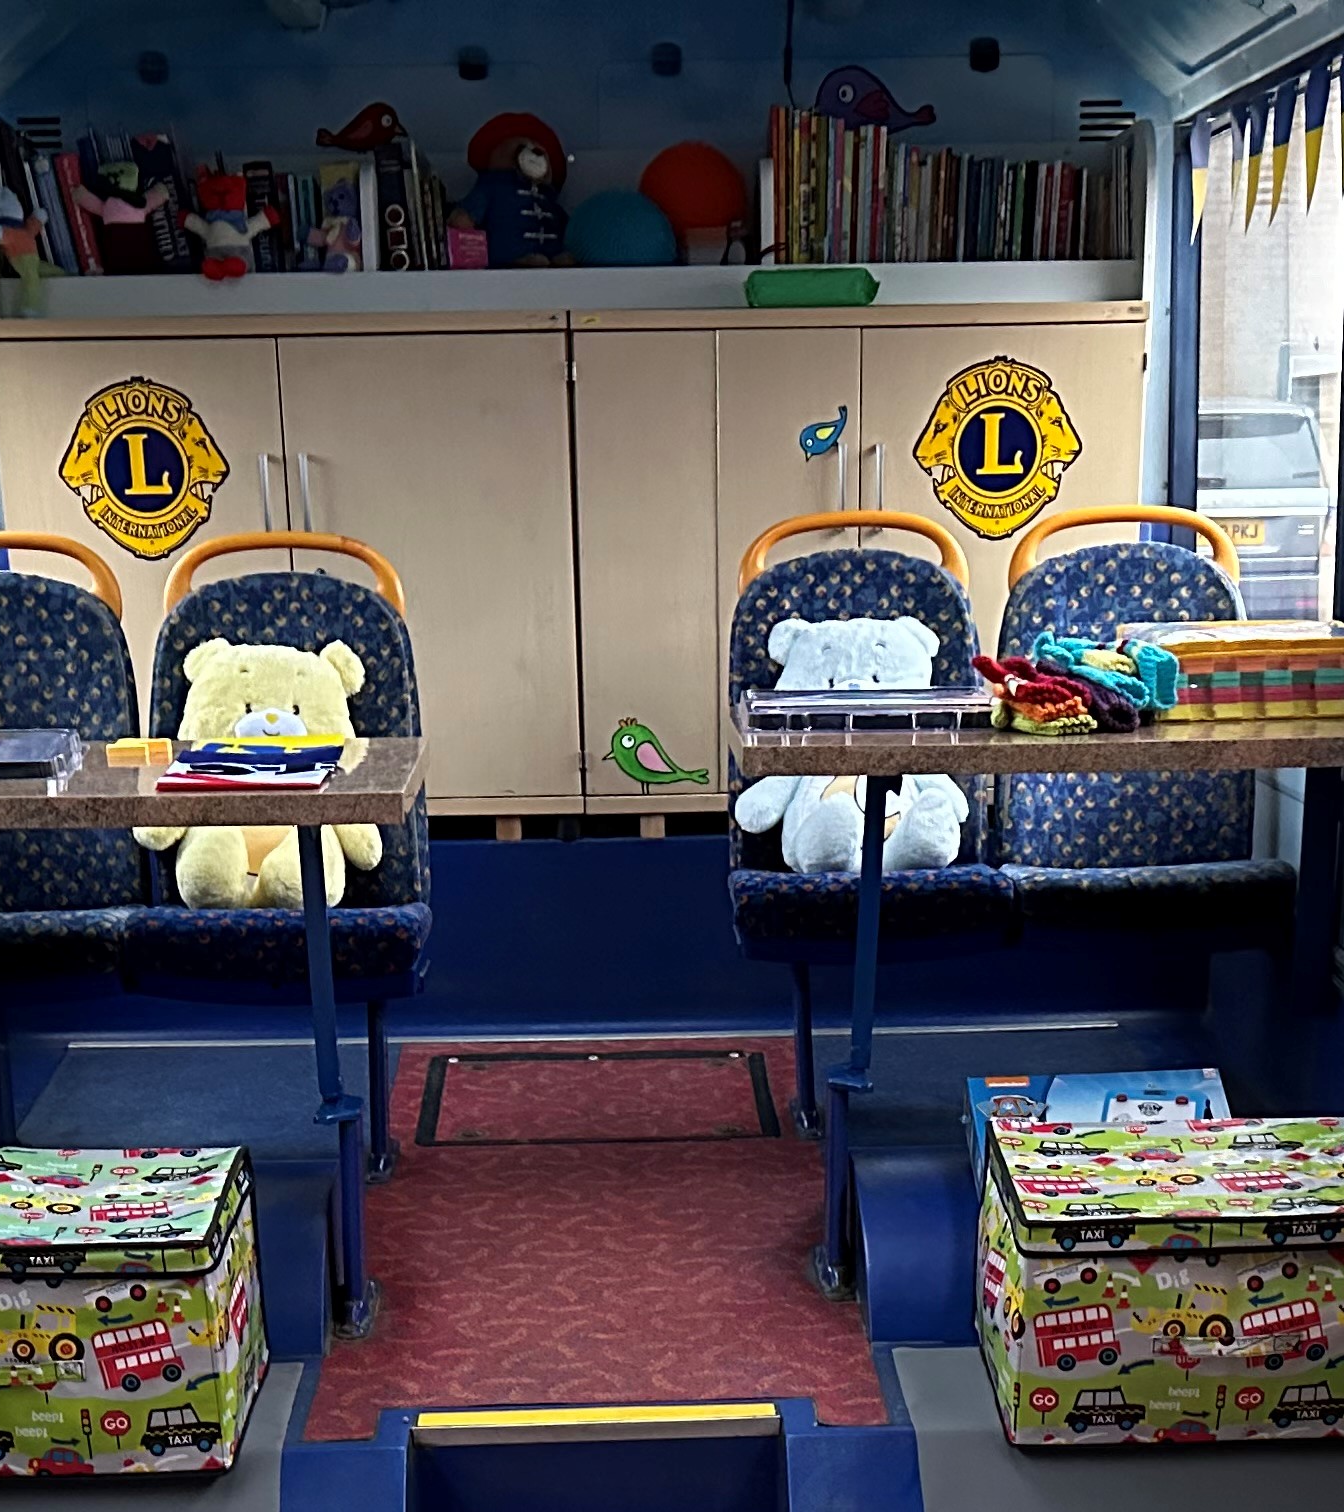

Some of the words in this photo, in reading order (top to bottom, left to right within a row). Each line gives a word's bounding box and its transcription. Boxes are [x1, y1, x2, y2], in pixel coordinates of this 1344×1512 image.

[957, 368, 1042, 405] LIONS
[92, 388, 181, 426] LIONS
[976, 412, 1024, 475] L
[122, 433, 173, 495] L
[948, 485, 1046, 519] INTERNATIONAL
[98, 505, 199, 539] INTERNATIONAL
[1233, 523, 1259, 541] PKJ
[1081, 1230, 1105, 1240] TAXI
[1292, 1225, 1316, 1235] TAXI
[29, 1255, 55, 1266] TAXI
[1033, 1395, 1056, 1406] GO
[1239, 1393, 1262, 1404] GO
[1092, 1415, 1116, 1425] TAXI
[1296, 1410, 1320, 1419] TAXI
[104, 1417, 128, 1429] GO
[168, 1435, 193, 1445] TAXI
